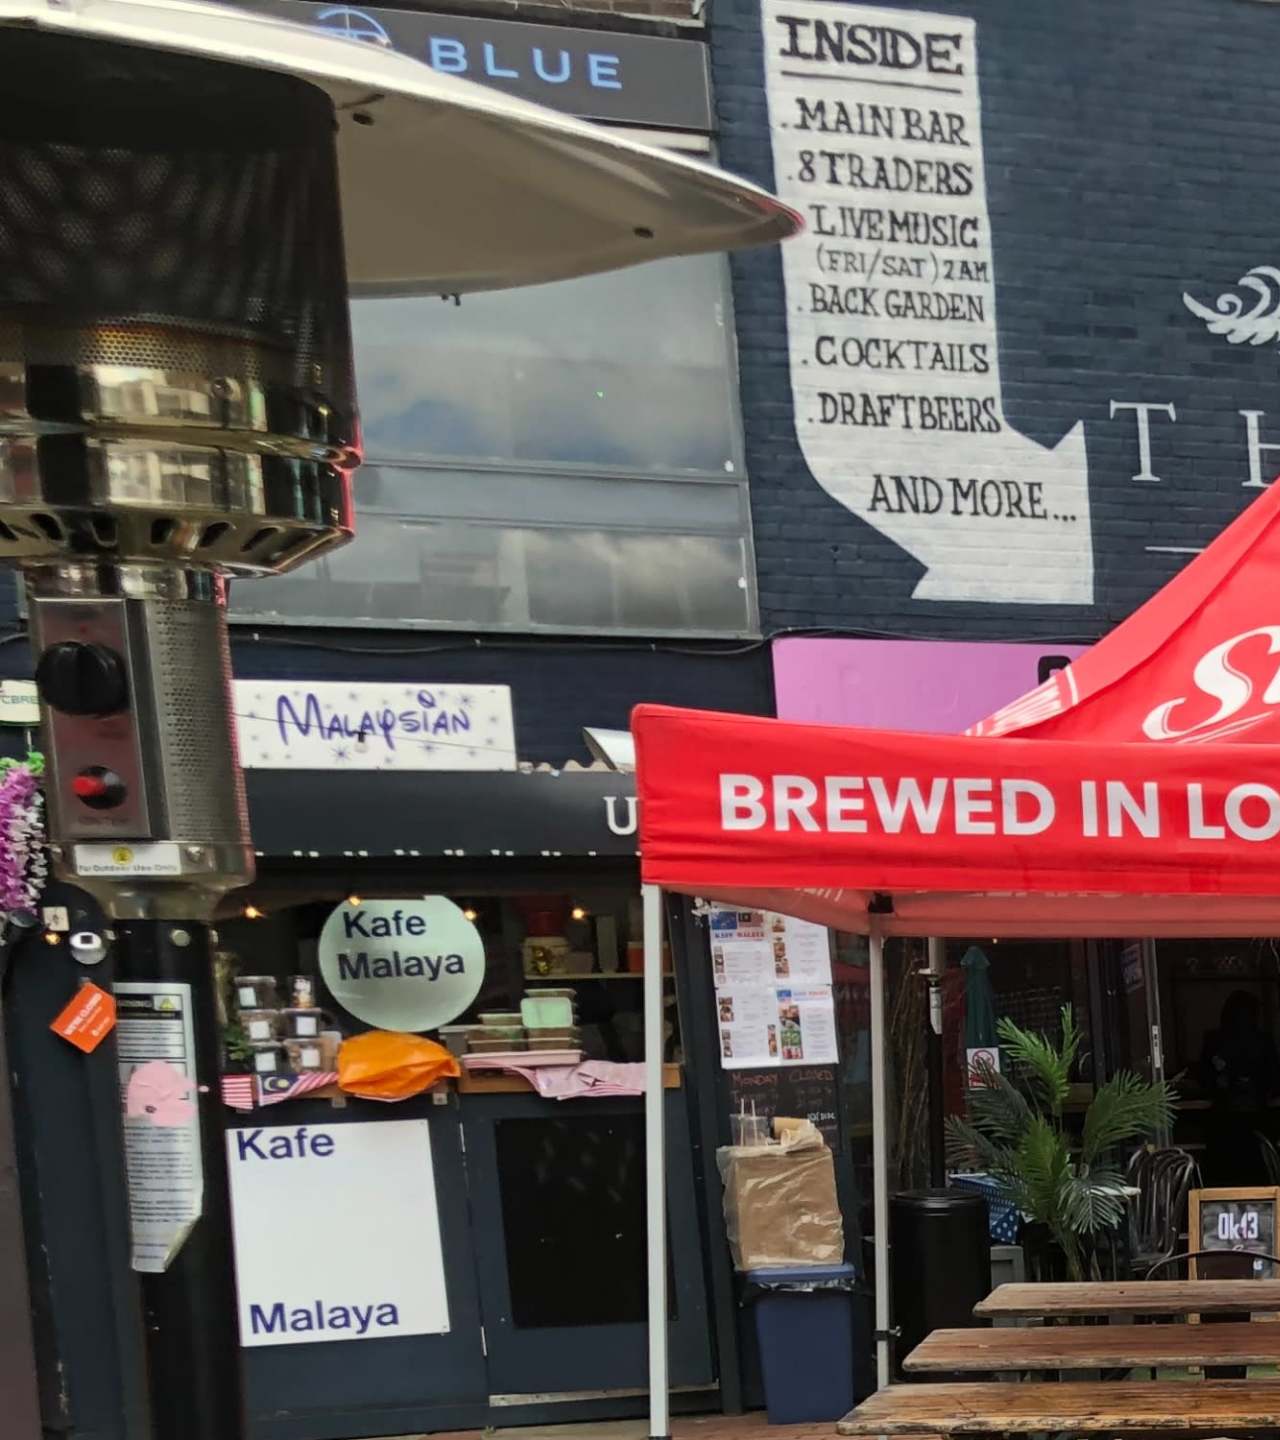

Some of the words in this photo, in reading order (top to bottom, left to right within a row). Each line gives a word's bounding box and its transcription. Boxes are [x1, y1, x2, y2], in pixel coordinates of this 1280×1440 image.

[429, 36, 623, 89] BLUE
[776, 15, 963, 76] INSIDE
[796, 98, 893, 140] MAIN
[905, 107, 970, 146] BAR
[816, 152, 974, 196] TRADERS
[808, 204, 884, 240] LIVE
[887, 210, 979, 249] MUSIC
[809, 283, 880, 316] BACK
[884, 289, 985, 322] GARDEN
[815, 335, 990, 374] COCKTAILS
[818, 392, 918, 428] DRAFT
[919, 396, 1002, 434] BEERS
[867, 474, 944, 515] AND
[719, 773, 1056, 837] BREWED
[1082, 780, 1160, 839] IN
[343, 909, 427, 939] Kafe
[337, 950, 465, 983] Malaya
[236, 1128, 335, 1161] Kafe
[249, 1300, 399, 1335] Malaya
